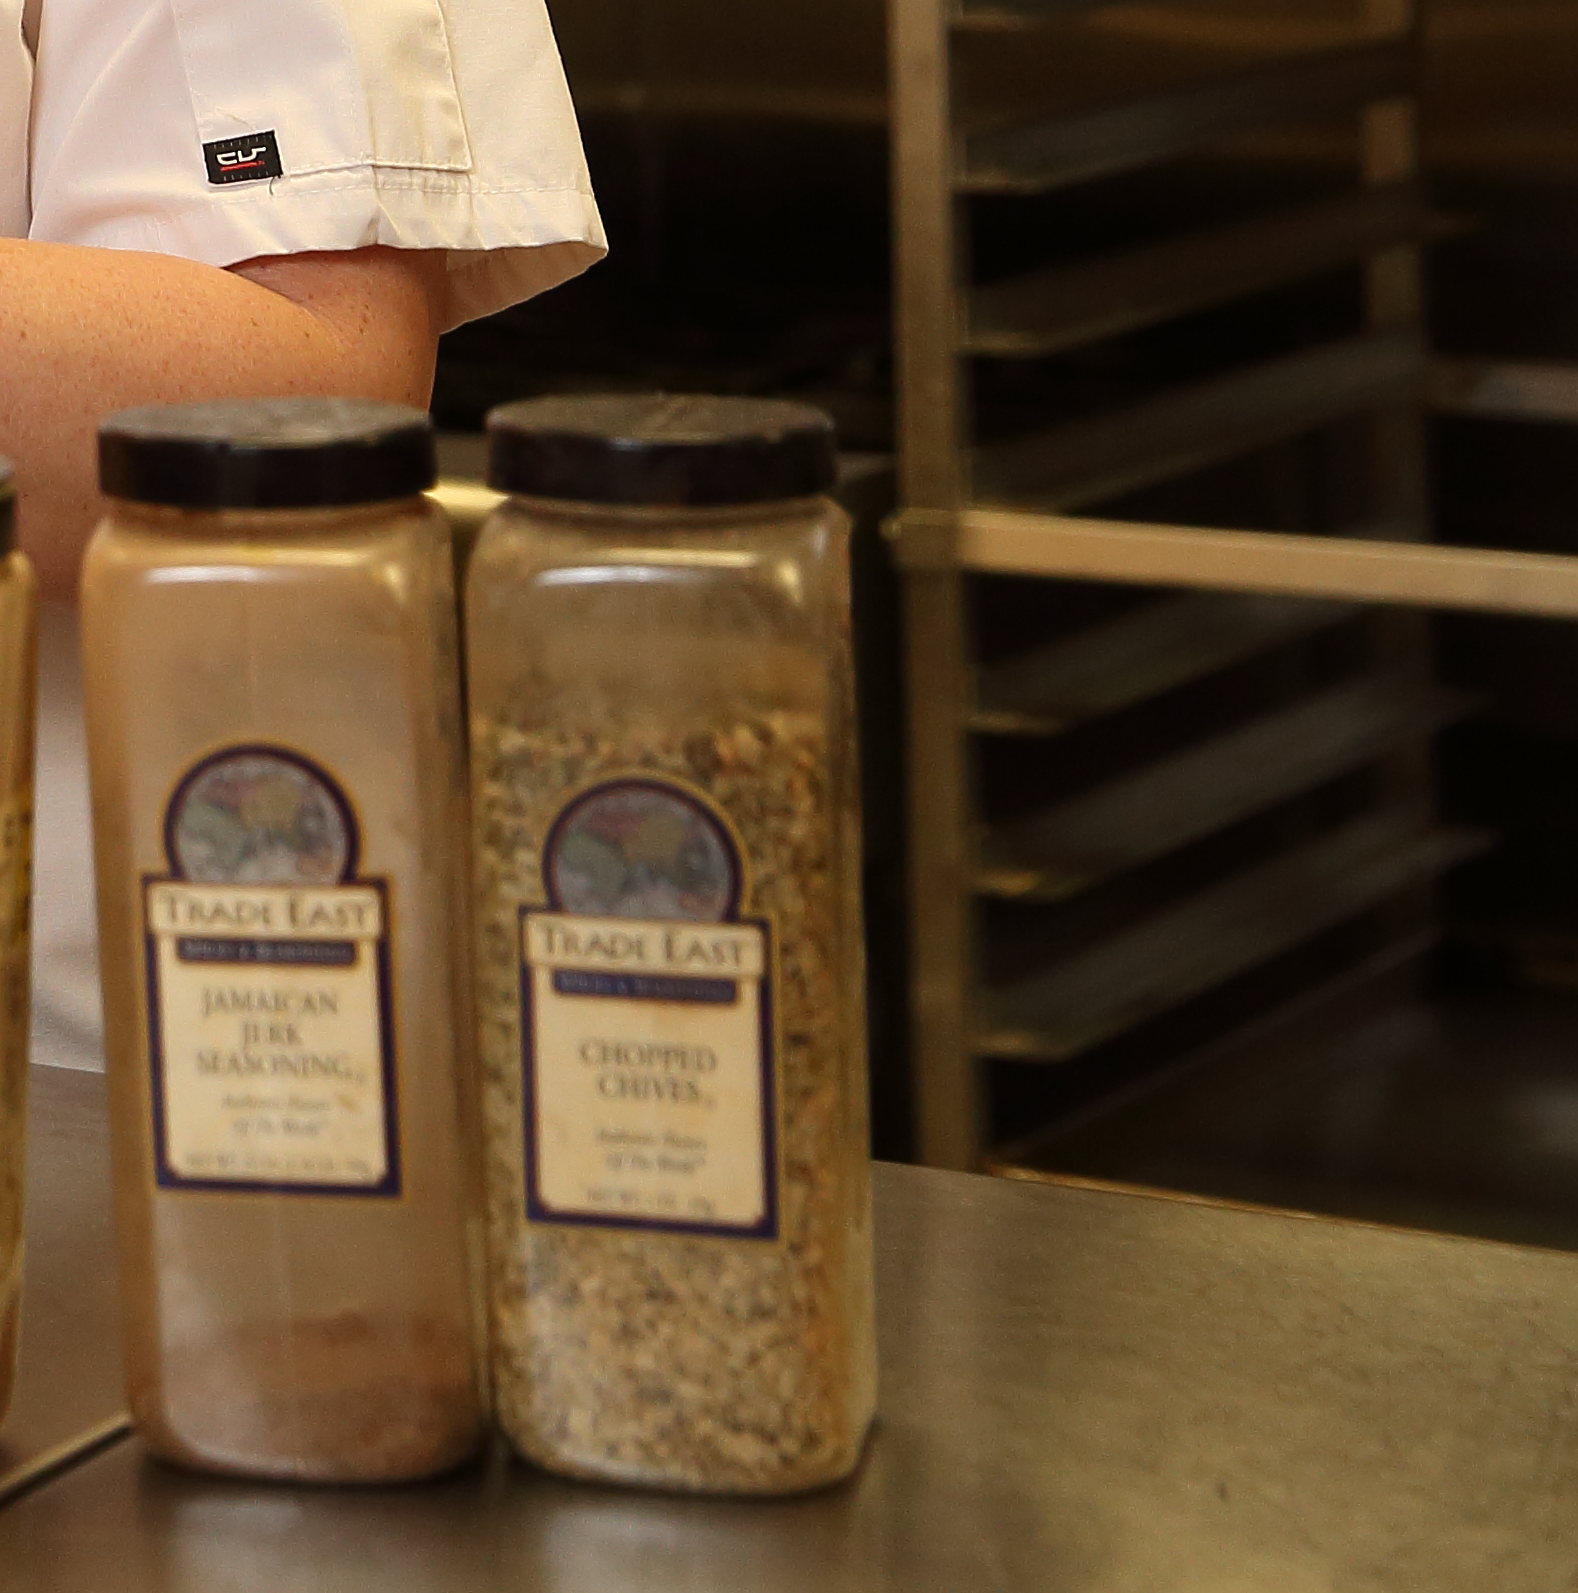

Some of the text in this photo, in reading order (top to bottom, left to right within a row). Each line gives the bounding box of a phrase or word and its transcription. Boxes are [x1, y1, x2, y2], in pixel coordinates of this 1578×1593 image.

[164, 894, 371, 930] TRADE EAST
[543, 924, 743, 964] TRADE EAST
[200, 986, 339, 1019] JAMAICAN
[240, 1021, 304, 1052] JERK
[196, 1049, 355, 1081] SEASONING
[578, 1039, 718, 1072] CHOPPED
[598, 1076, 700, 1103] CHIVES
